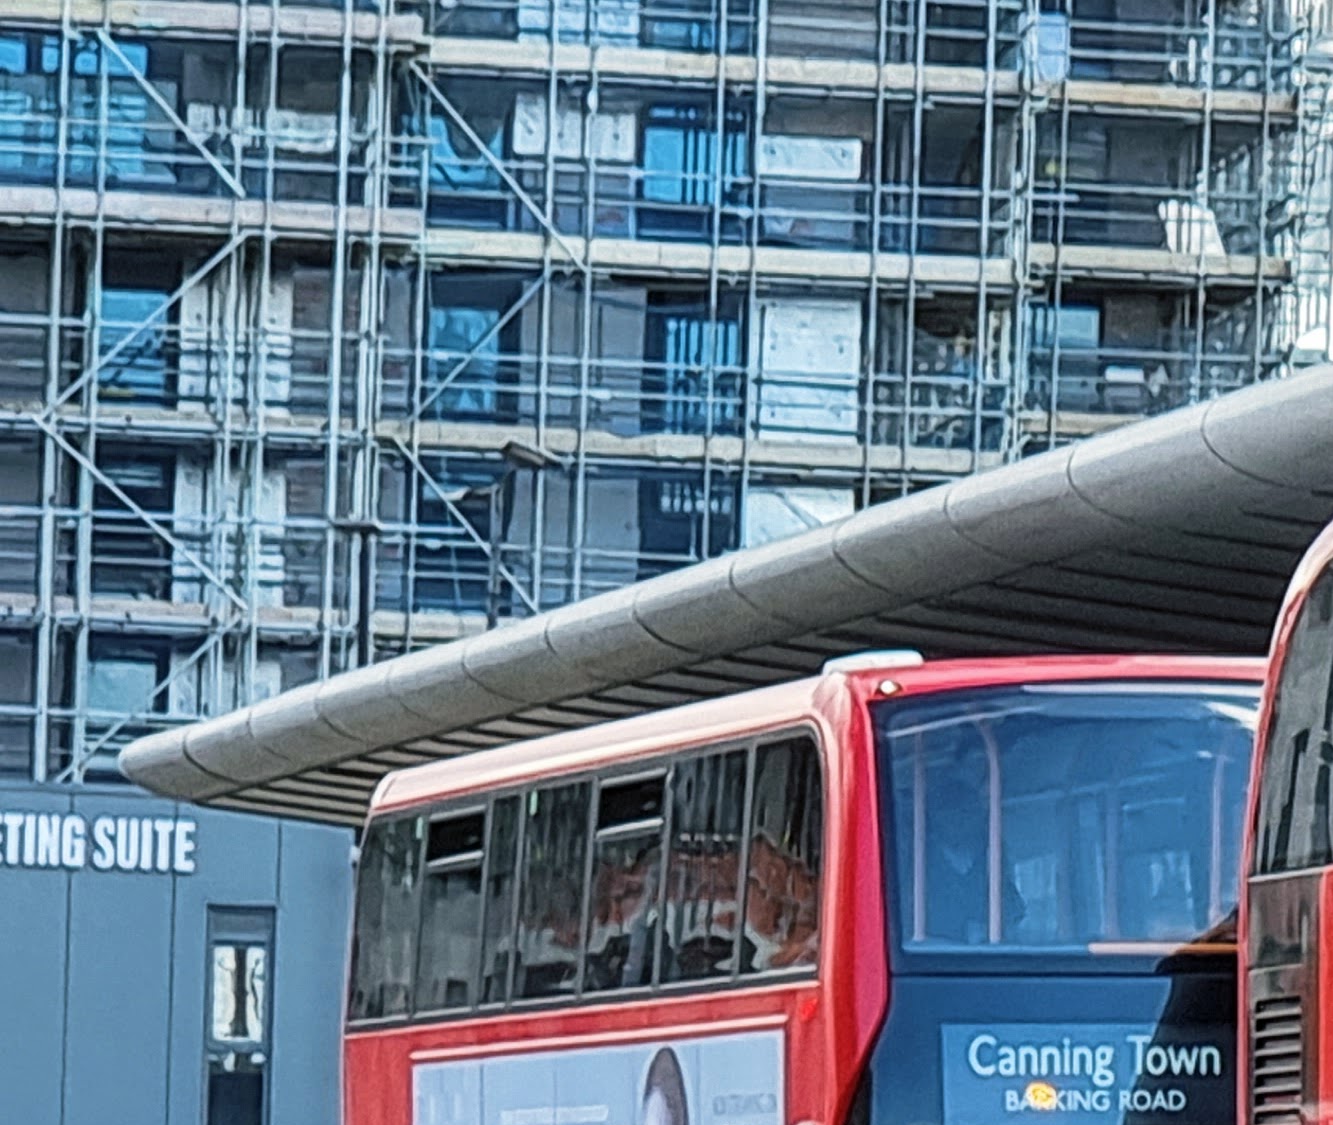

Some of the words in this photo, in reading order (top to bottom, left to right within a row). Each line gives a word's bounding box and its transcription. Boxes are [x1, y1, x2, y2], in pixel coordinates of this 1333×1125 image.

[0, 811, 86, 868] TING
[93, 816, 196, 872] SUITE
[968, 1034, 1115, 1087] Canning
[1126, 1034, 1221, 1076] Town
[1005, 1089, 1111, 1112] BAKING
[1119, 1089, 1187, 1112] ROAD
